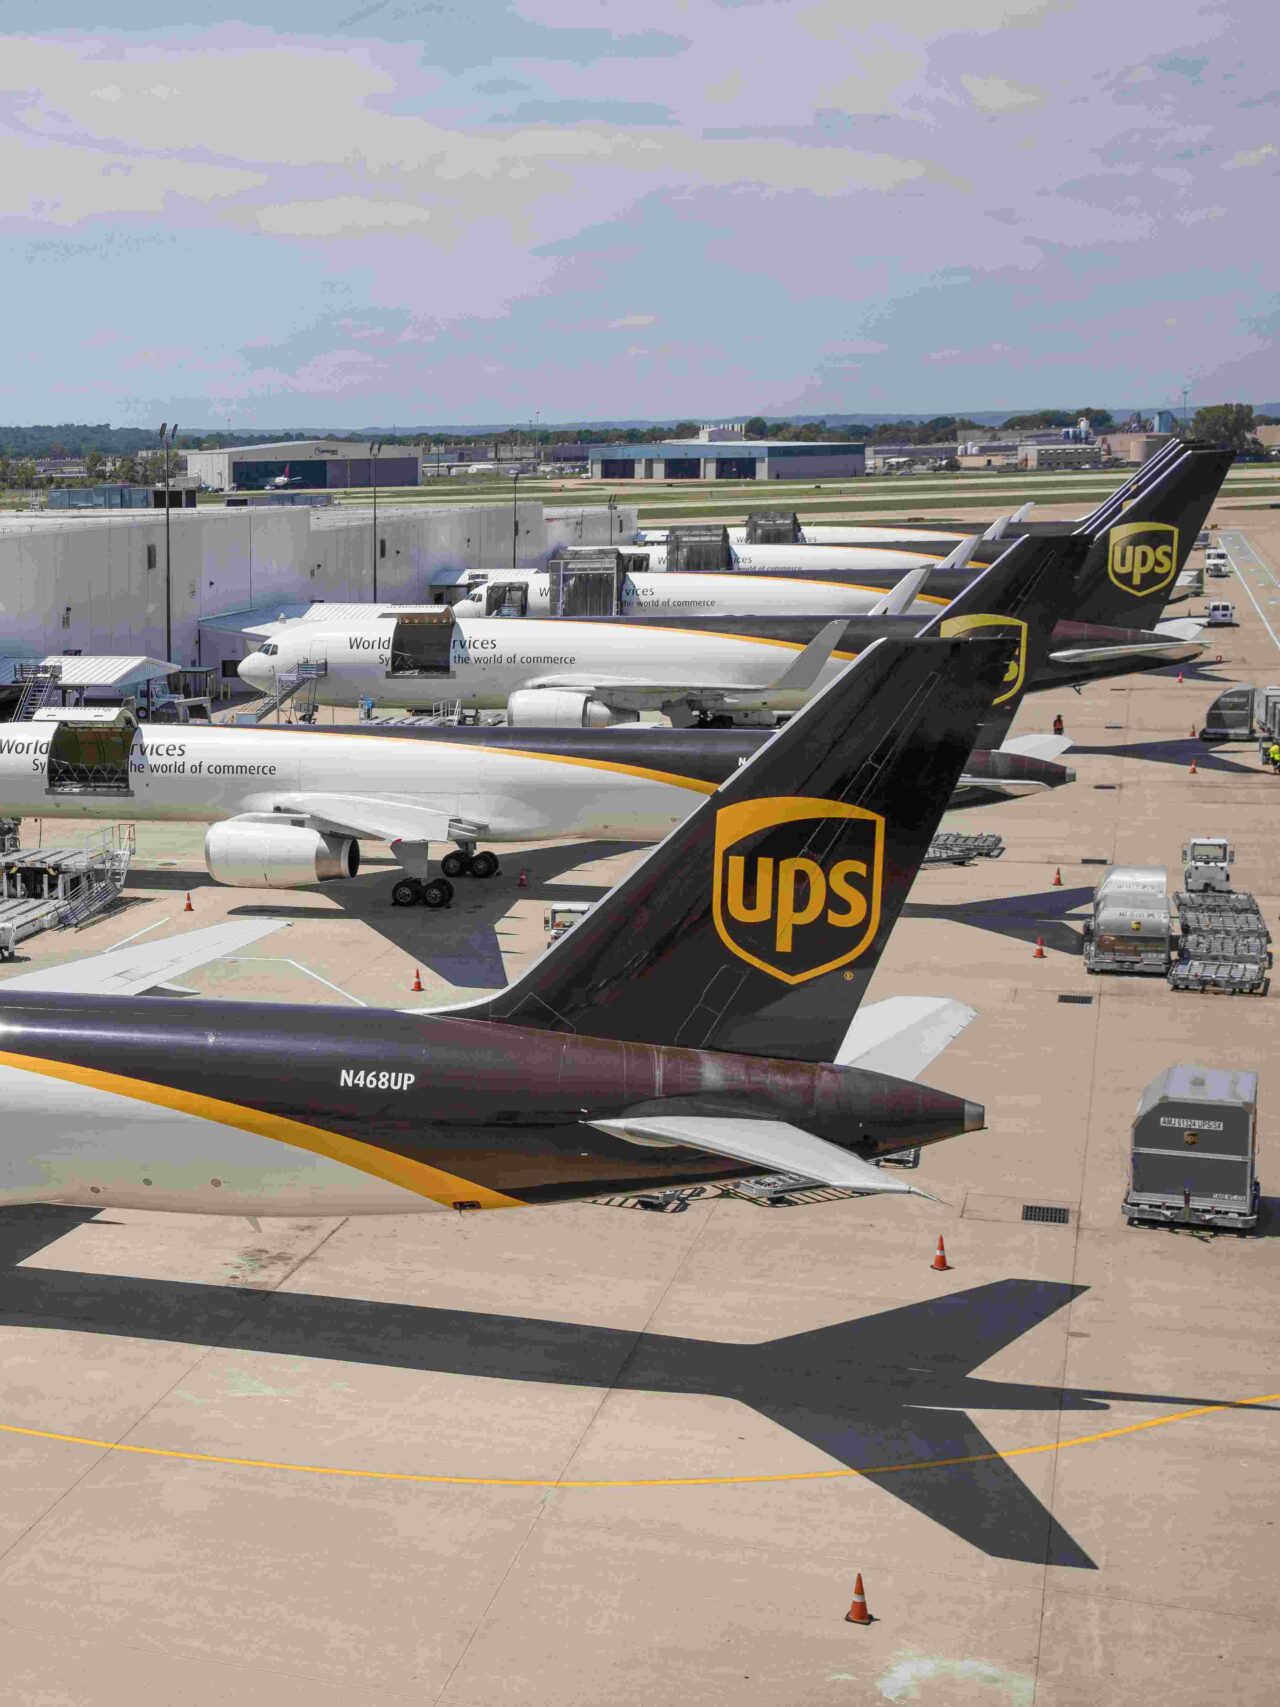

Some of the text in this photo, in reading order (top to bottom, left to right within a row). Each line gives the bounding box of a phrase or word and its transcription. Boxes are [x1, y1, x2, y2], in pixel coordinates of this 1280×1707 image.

[1113, 545, 1173, 585] ups
[454, 654, 470, 664] the
[473, 654, 502, 664] world
[506, 653, 517, 664] of
[520, 655, 576, 665] commerce
[150, 761, 185, 774] world
[190, 761, 203, 774] of
[207, 764, 277, 775] commerce
[727, 856, 867, 952] ups
[340, 1069, 415, 1090] N468UP
